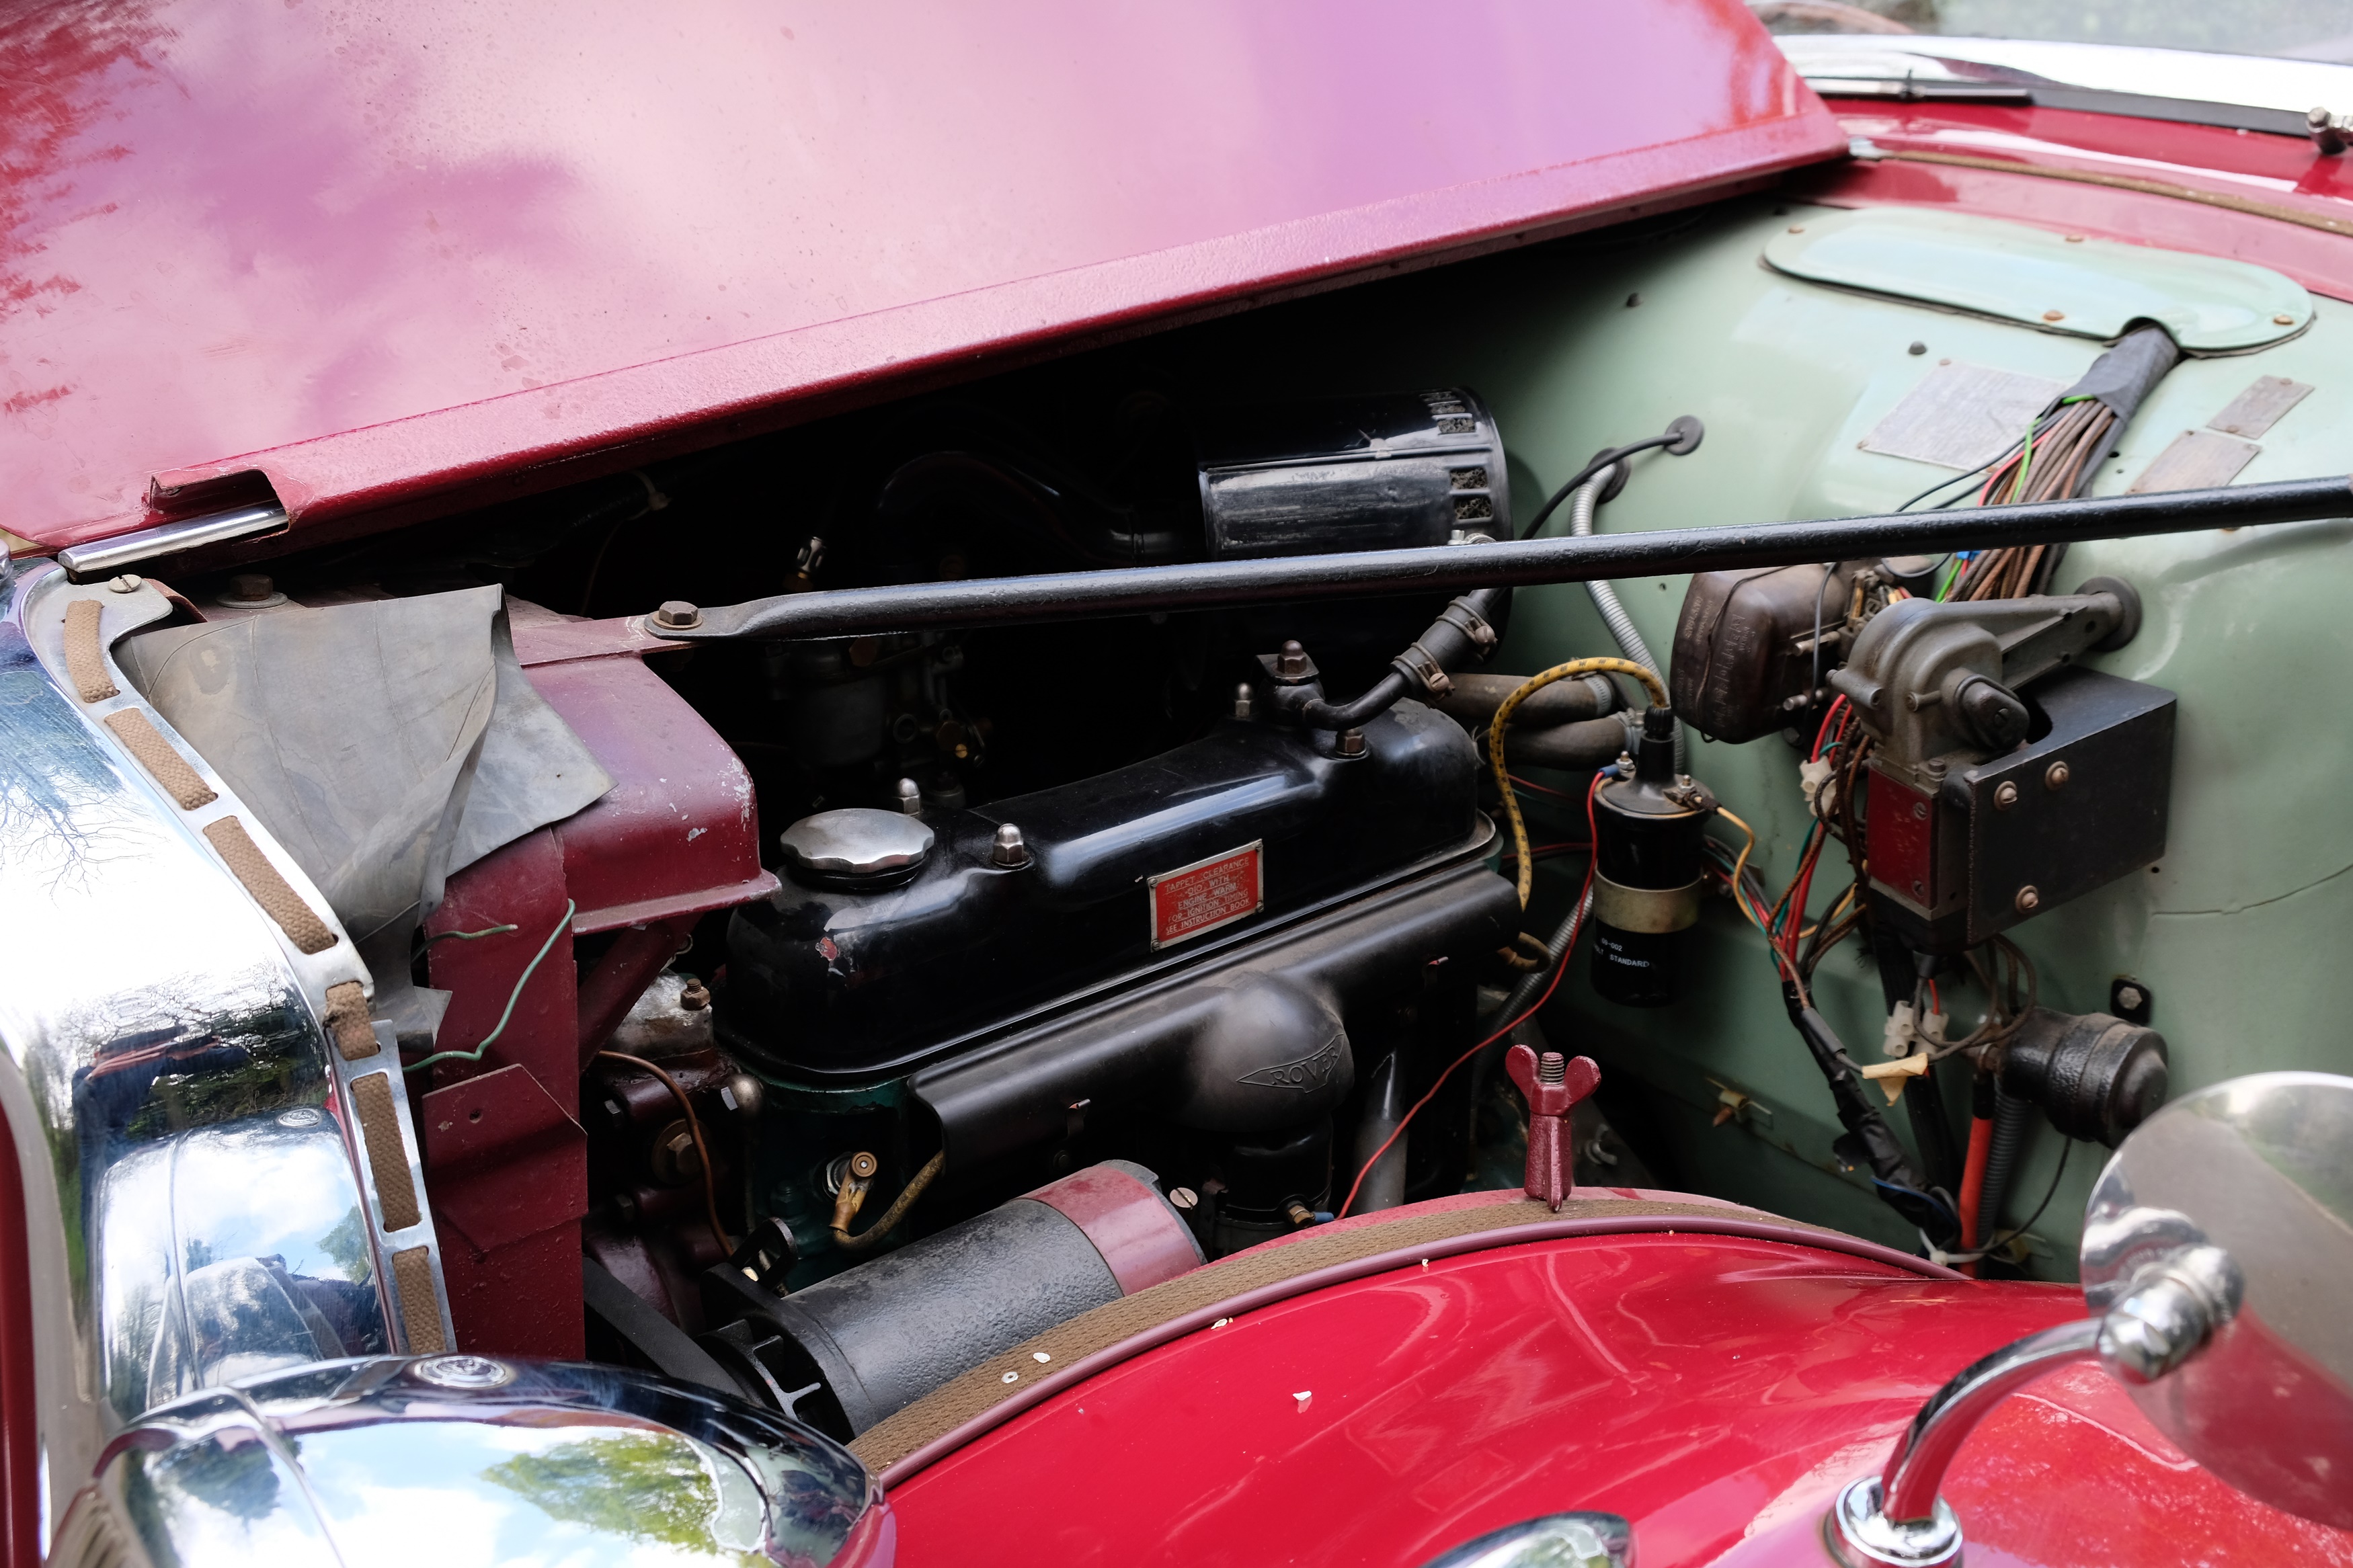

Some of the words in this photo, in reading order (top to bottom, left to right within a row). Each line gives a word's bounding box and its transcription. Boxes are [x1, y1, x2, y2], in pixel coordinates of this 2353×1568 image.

[1165, 876, 1195, 893] TAPPET
[1203, 857, 1250, 879] CLEARANCE
[1209, 874, 1230, 888] WITH
[1178, 893, 1207, 910] ENGINE
[1213, 882, 1236, 897] WARM
[1187, 900, 1219, 916] IGNITION
[1224, 889, 1248, 903] TIMING
[1166, 923, 1177, 934] SEE
[1181, 906, 1226, 929] INSTRUCTION
[1230, 897, 1250, 911] BOOK
[1609, 954, 1650, 967] STANDARD
[1270, 1046, 1339, 1085] ROVER
